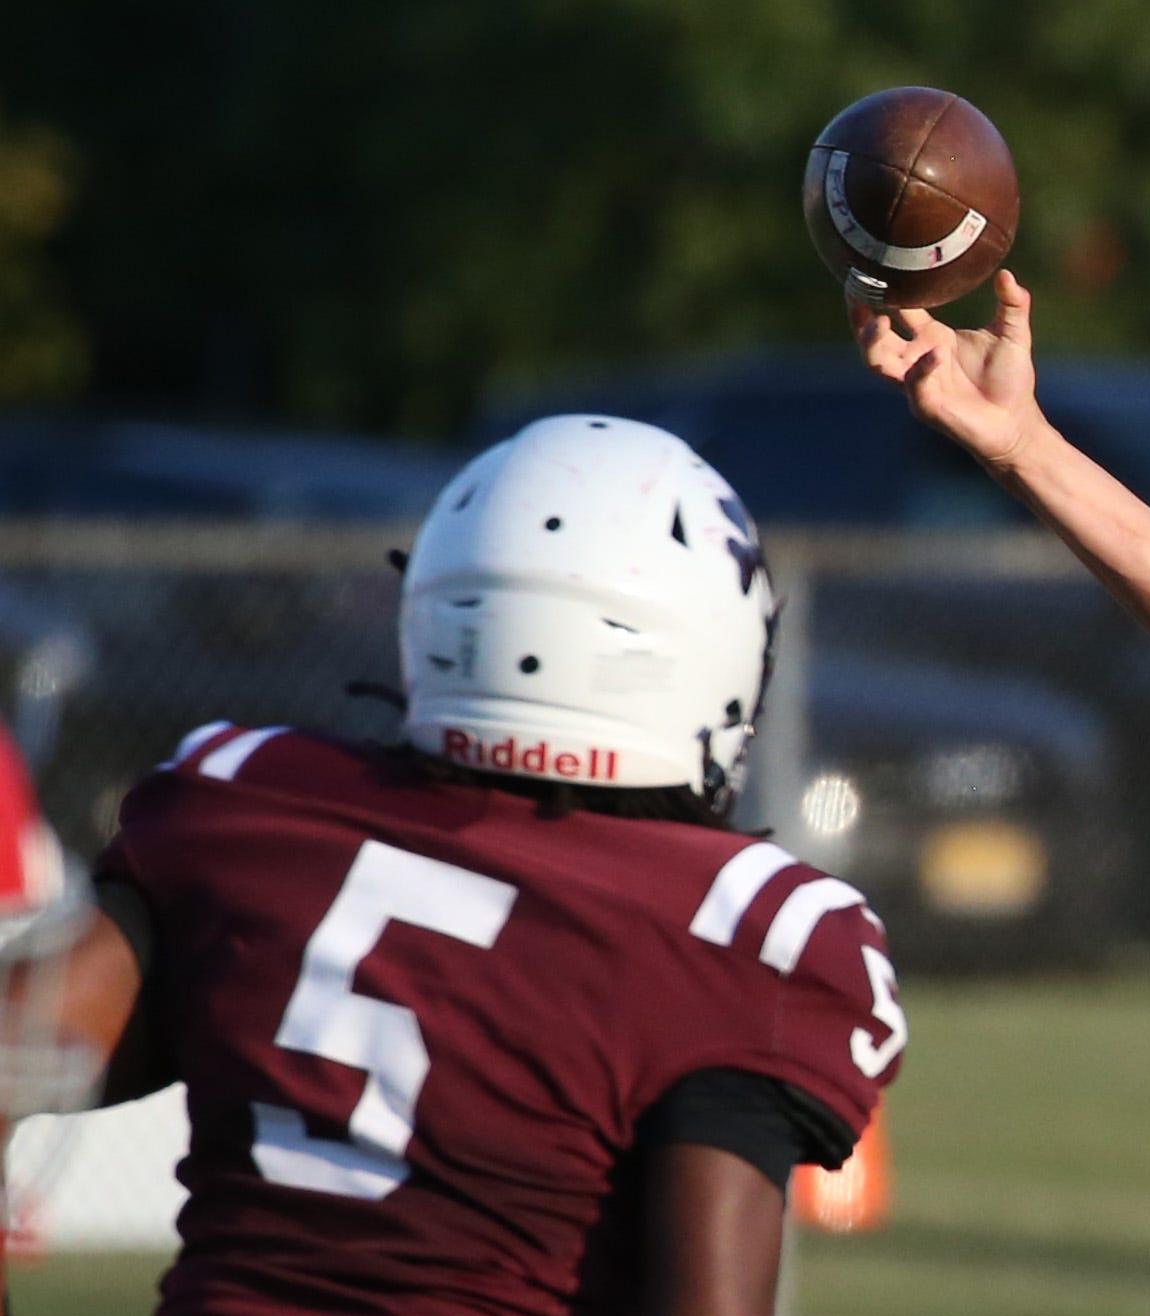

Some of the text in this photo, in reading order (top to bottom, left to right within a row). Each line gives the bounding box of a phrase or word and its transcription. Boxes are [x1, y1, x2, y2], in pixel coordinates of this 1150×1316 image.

[442, 728, 618, 781] Riddell
[251, 838, 517, 1199] 5
[849, 943, 909, 1079] 5
